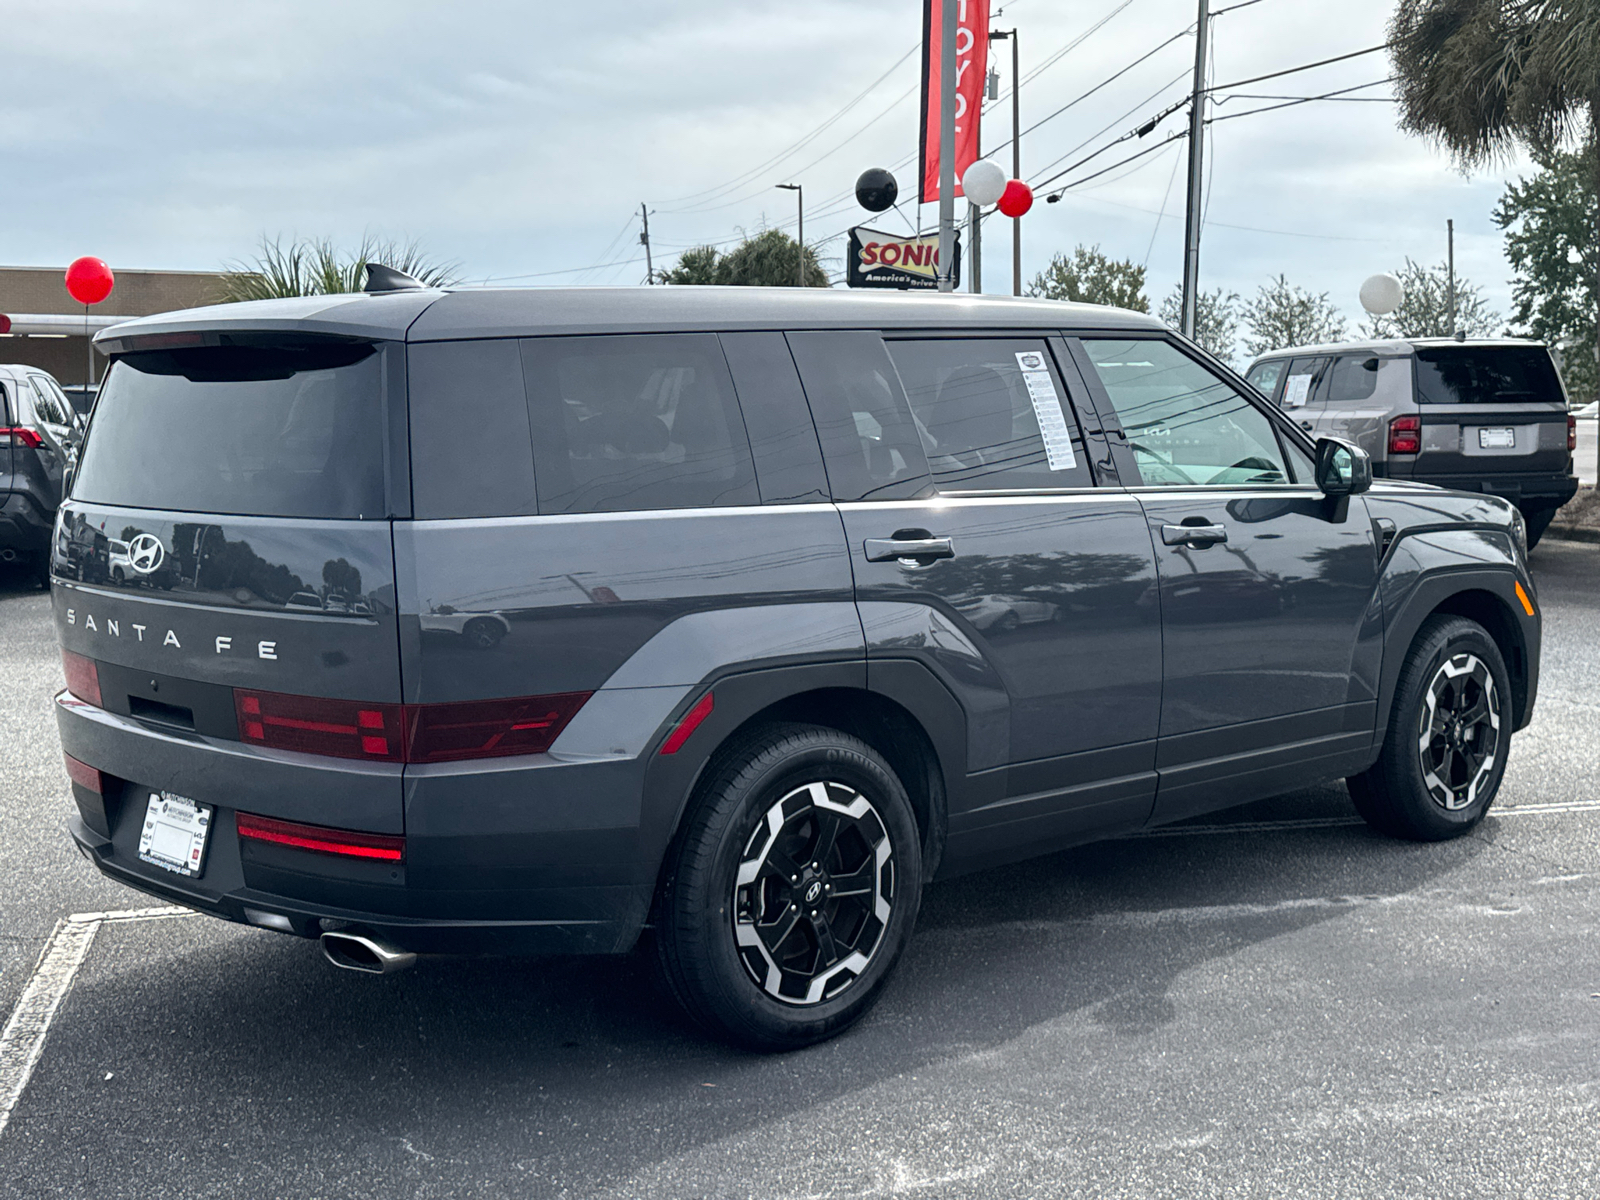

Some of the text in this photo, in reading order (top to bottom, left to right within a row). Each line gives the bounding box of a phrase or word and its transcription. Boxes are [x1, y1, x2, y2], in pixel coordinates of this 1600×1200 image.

[862, 242, 939, 266] SONI
[865, 273, 939, 287] America's Drive-
[66, 608, 278, 660] SANTA FE
